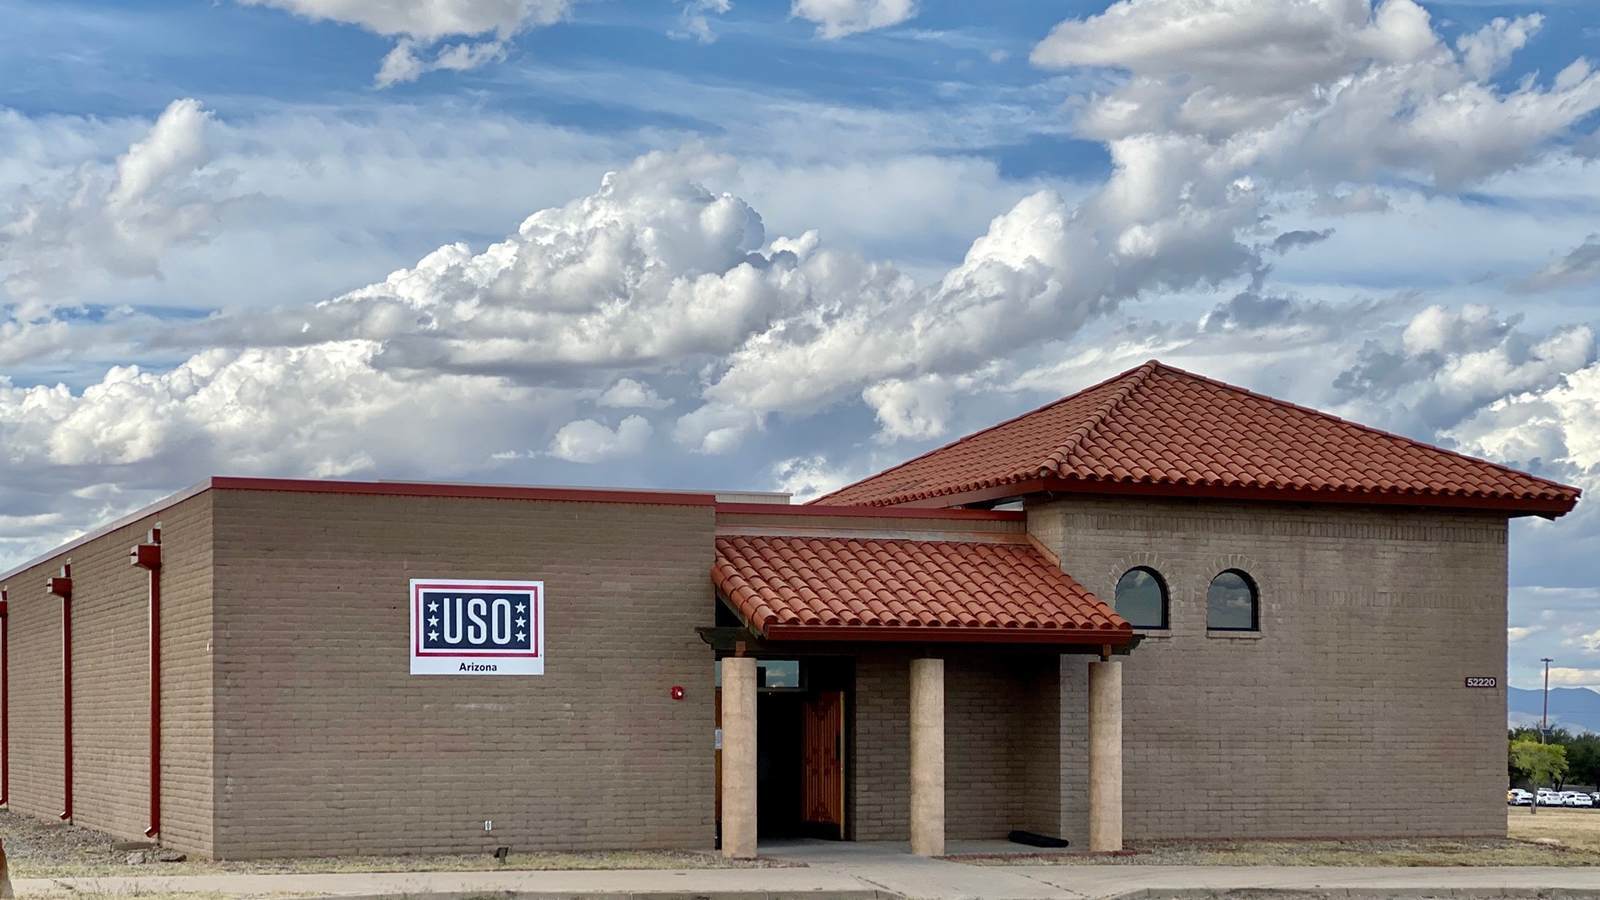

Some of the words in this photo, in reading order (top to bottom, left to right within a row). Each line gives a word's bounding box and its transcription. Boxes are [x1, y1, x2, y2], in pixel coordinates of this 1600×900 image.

[443, 597, 511, 645] USO
[459, 662, 497, 671] Arizona
[1467, 678, 1496, 687] 52220
